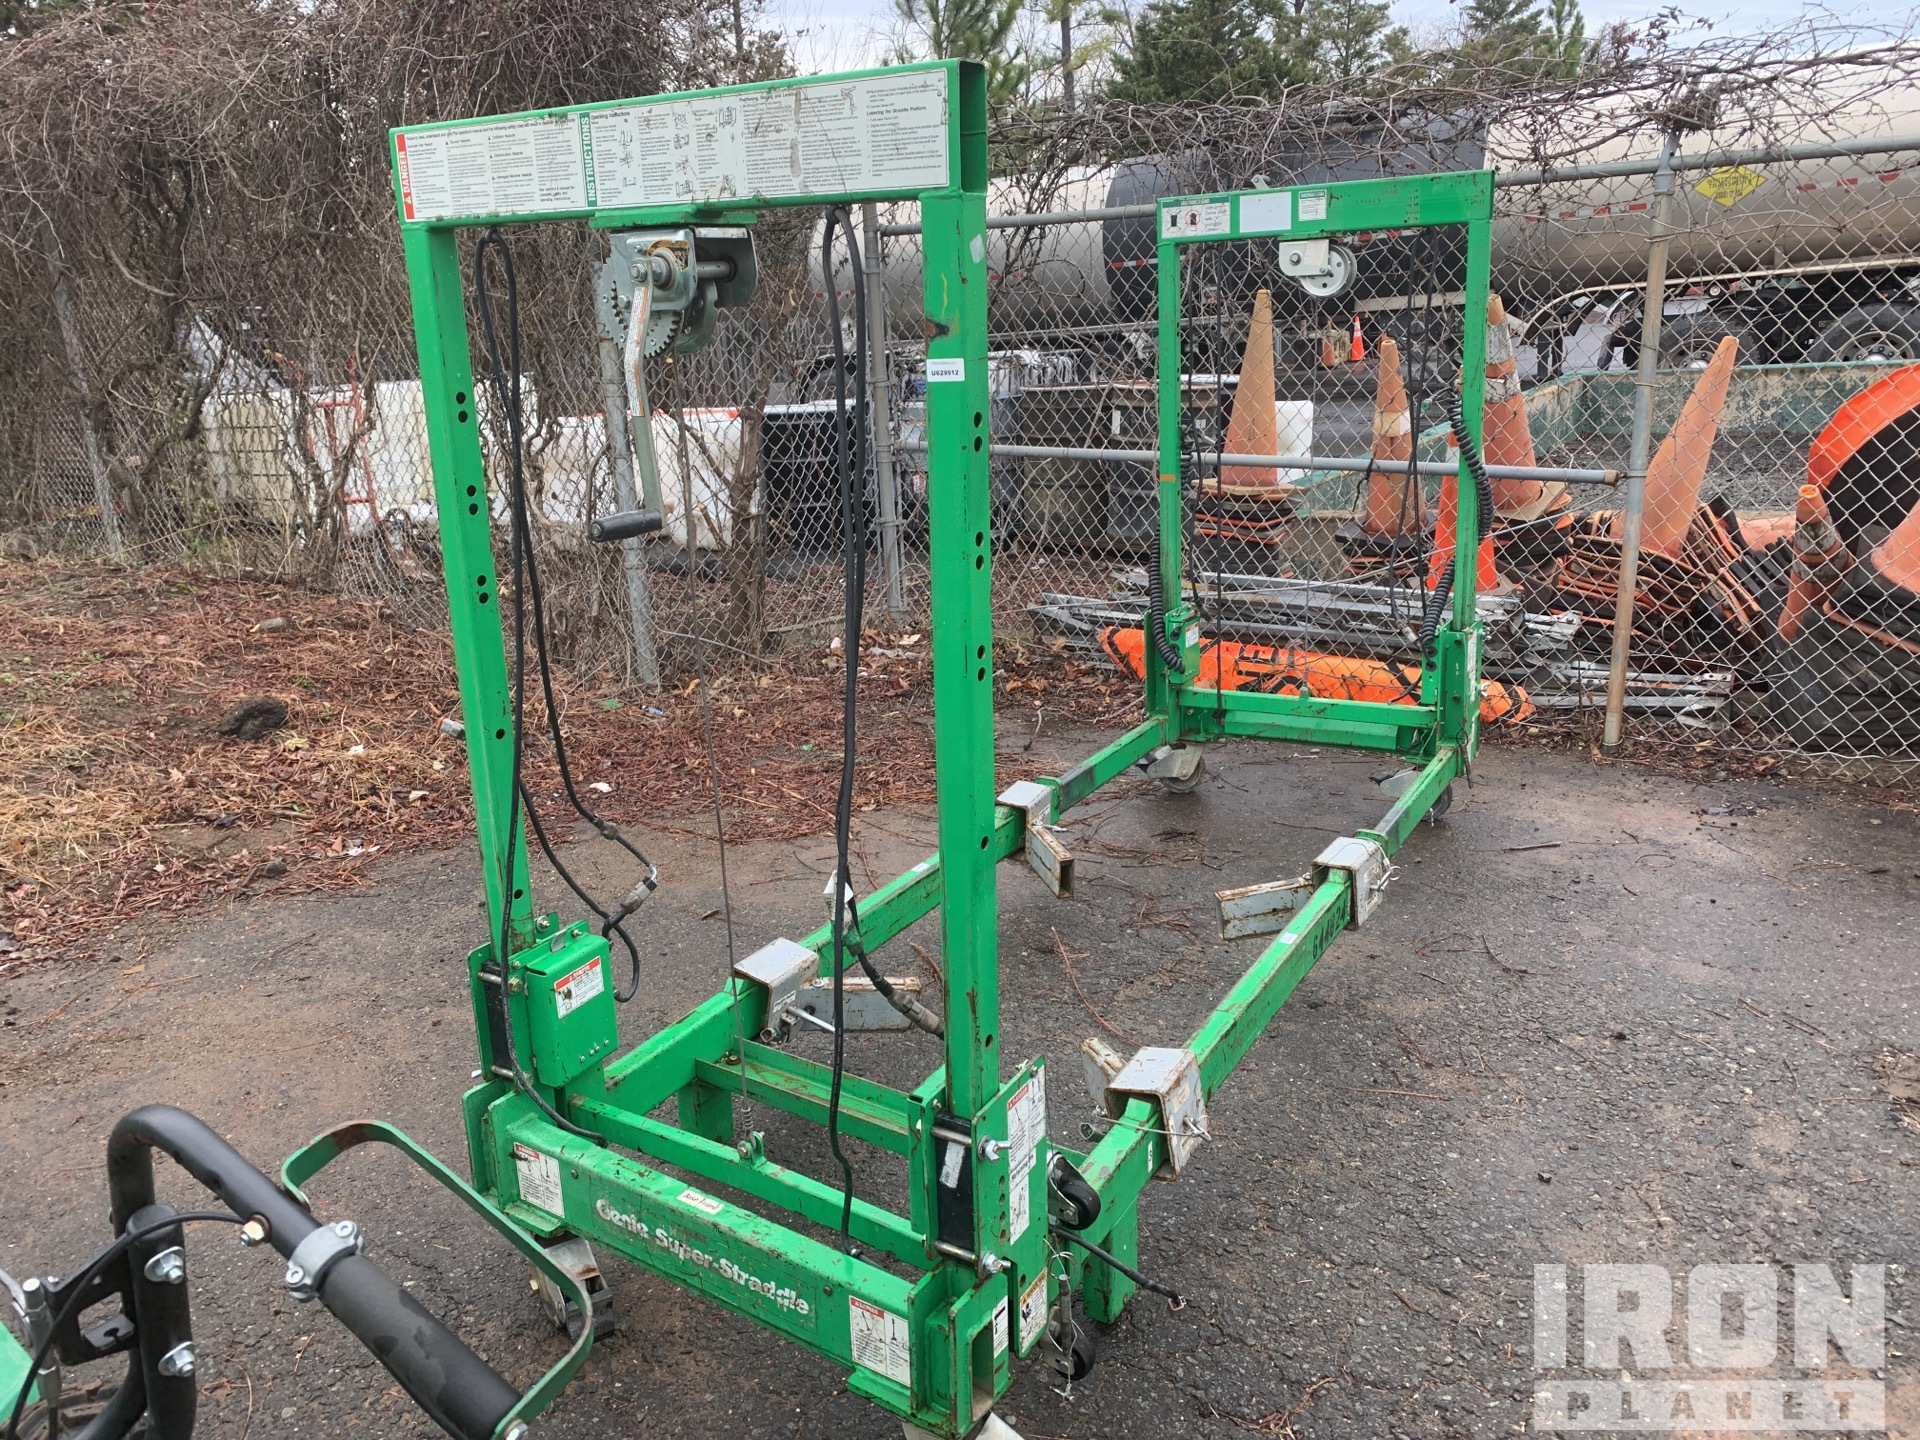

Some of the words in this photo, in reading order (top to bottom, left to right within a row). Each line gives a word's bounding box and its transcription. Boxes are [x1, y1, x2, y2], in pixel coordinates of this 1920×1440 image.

[399, 151, 412, 193] DANGER
[581, 117, 596, 201] INSTRUCTIONS
[596, 1198, 650, 1240] Genie
[655, 1227, 810, 1315] Super-Straddle
